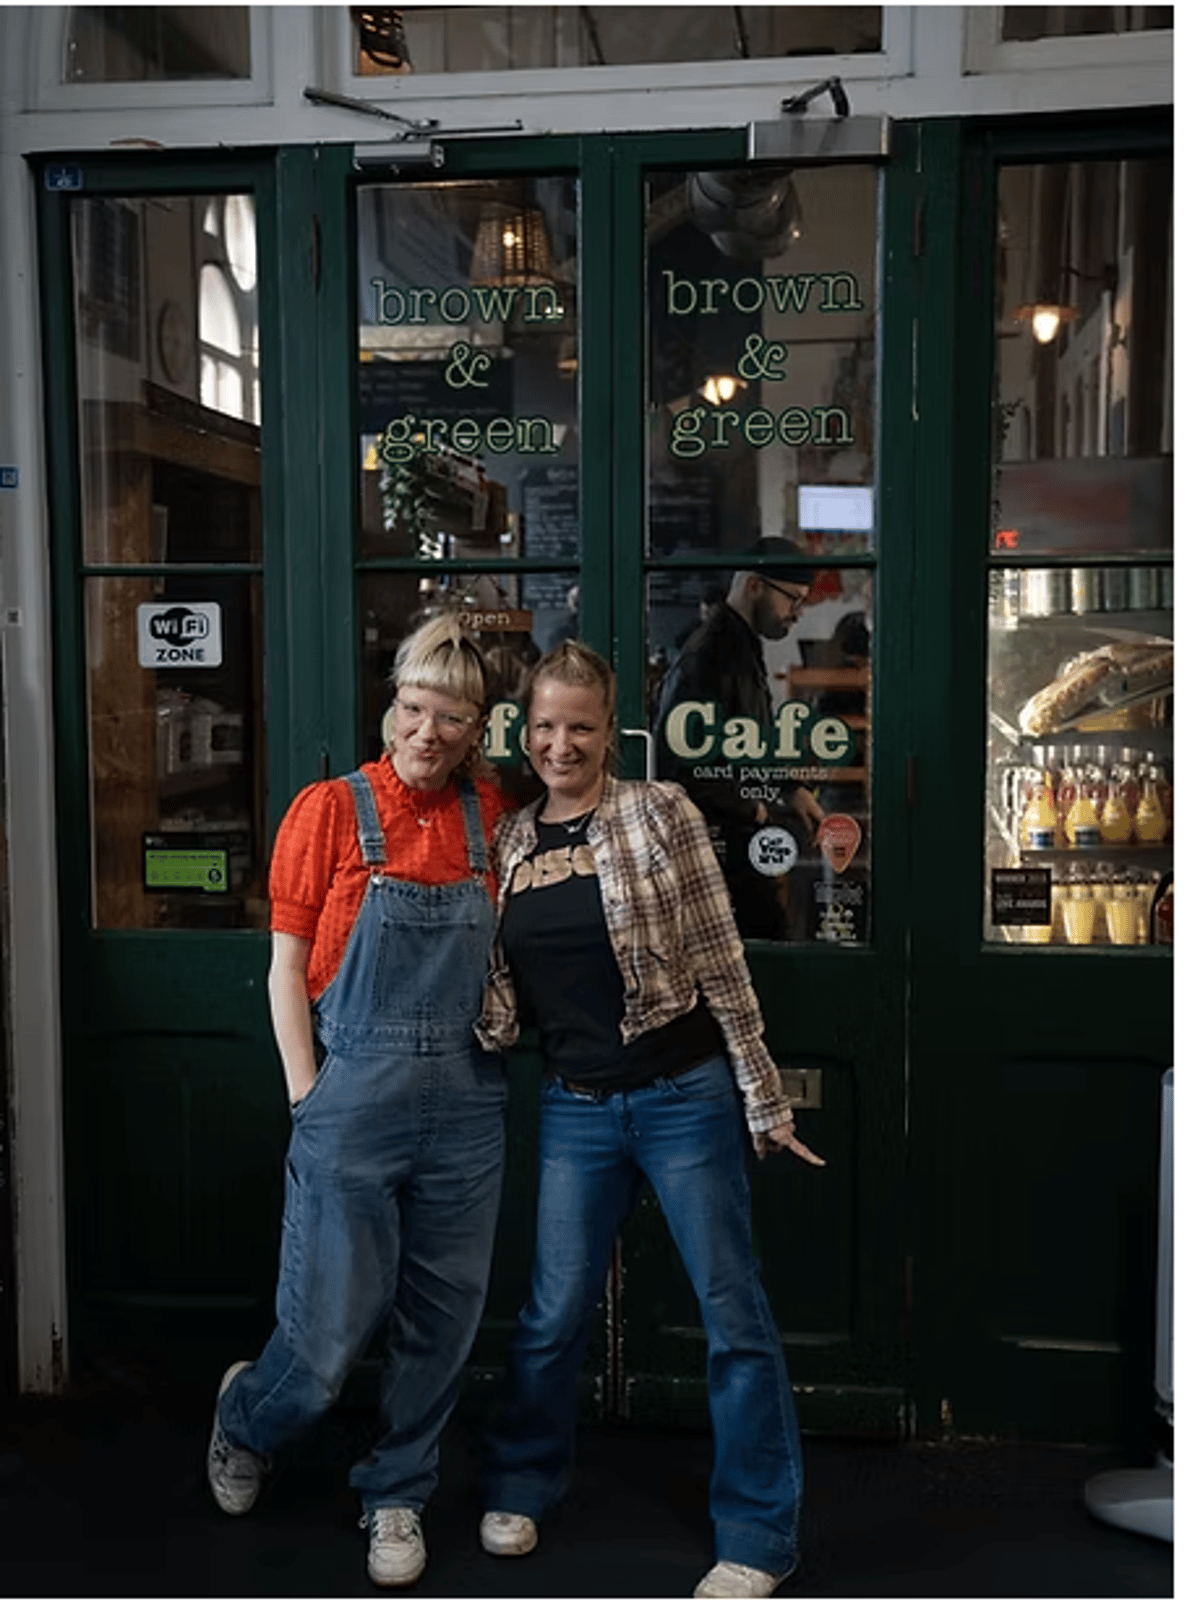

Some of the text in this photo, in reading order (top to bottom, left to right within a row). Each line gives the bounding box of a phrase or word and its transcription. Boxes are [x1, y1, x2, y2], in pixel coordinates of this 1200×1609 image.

[371, 279, 565, 323] brown
[662, 269, 862, 314] brown
[445, 342, 491, 388] &
[738, 333, 787, 380] &
[382, 413, 561, 463] green
[672, 405, 854, 458] green
[156, 648, 205, 662] ZONE
[665, 700, 849, 760] Cafe
[693, 765, 829, 783] card payments
